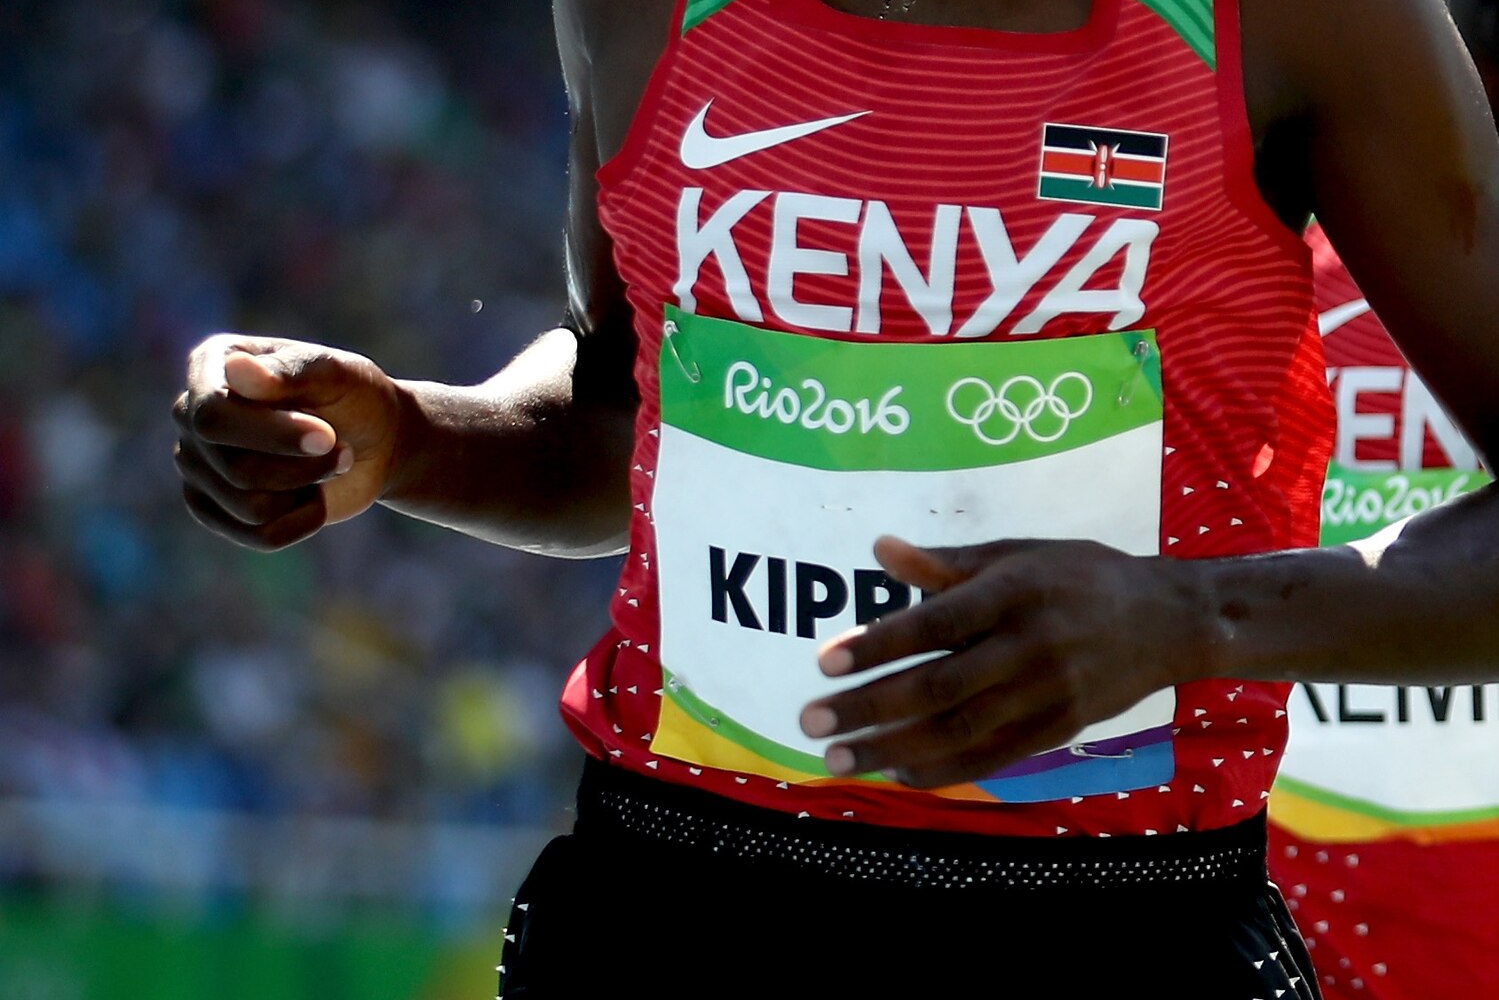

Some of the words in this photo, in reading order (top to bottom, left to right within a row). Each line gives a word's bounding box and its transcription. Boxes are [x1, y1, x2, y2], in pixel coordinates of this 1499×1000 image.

[672, 187, 1160, 337] KENYA
[725, 361, 910, 435] Rio2016
[1326, 365, 1481, 473] EN
